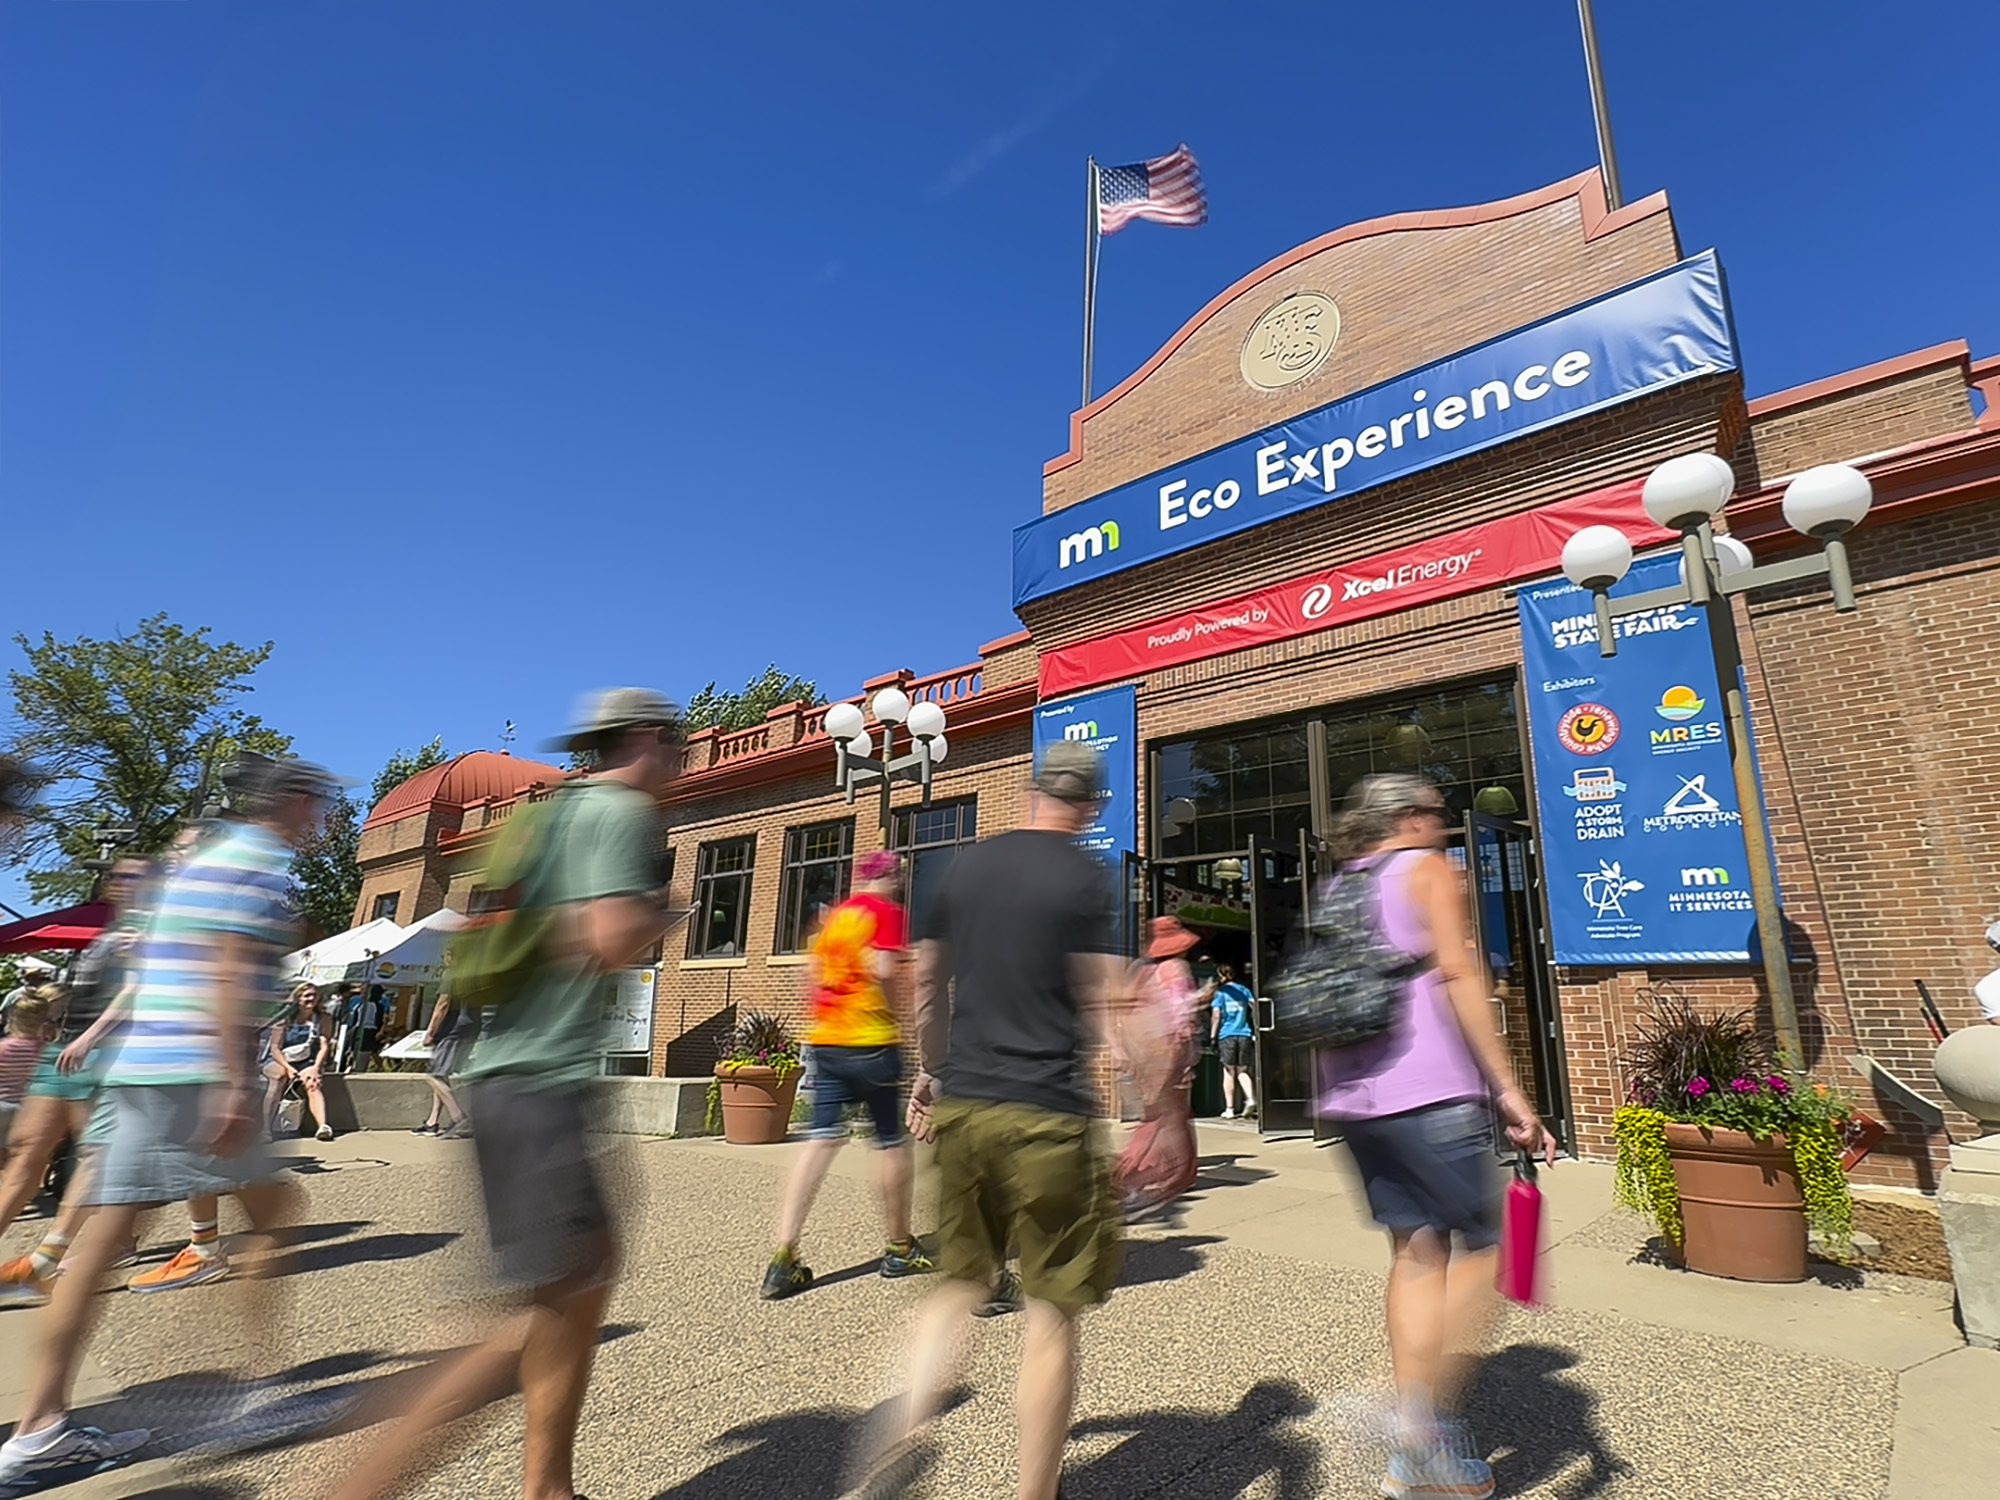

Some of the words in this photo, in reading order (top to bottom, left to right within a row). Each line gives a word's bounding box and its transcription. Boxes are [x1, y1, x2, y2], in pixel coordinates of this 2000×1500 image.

[1159, 478, 1241, 532] Eco
[1255, 349, 1592, 493] Experience
[1341, 569, 1396, 602] Xcel
[1396, 552, 1475, 588] Energy
[1147, 625, 1193, 649] Proudly
[1194, 610, 1250, 636] Powered
[1252, 607, 1270, 624] by
[1624, 613, 1678, 638] FAIR
[1542, 677, 1596, 693] Exhibitors
[1650, 722, 1722, 745] MRES
[1574, 803, 1622, 818] ADOPT
[1576, 818, 1584, 827] A
[1585, 816, 1622, 827] STORM
[1576, 825, 1625, 841] DRAIN
[1668, 890, 1751, 902] MINNESOTA
[1669, 903, 1682, 912] IT
[1686, 900, 1754, 912] SERVICES
